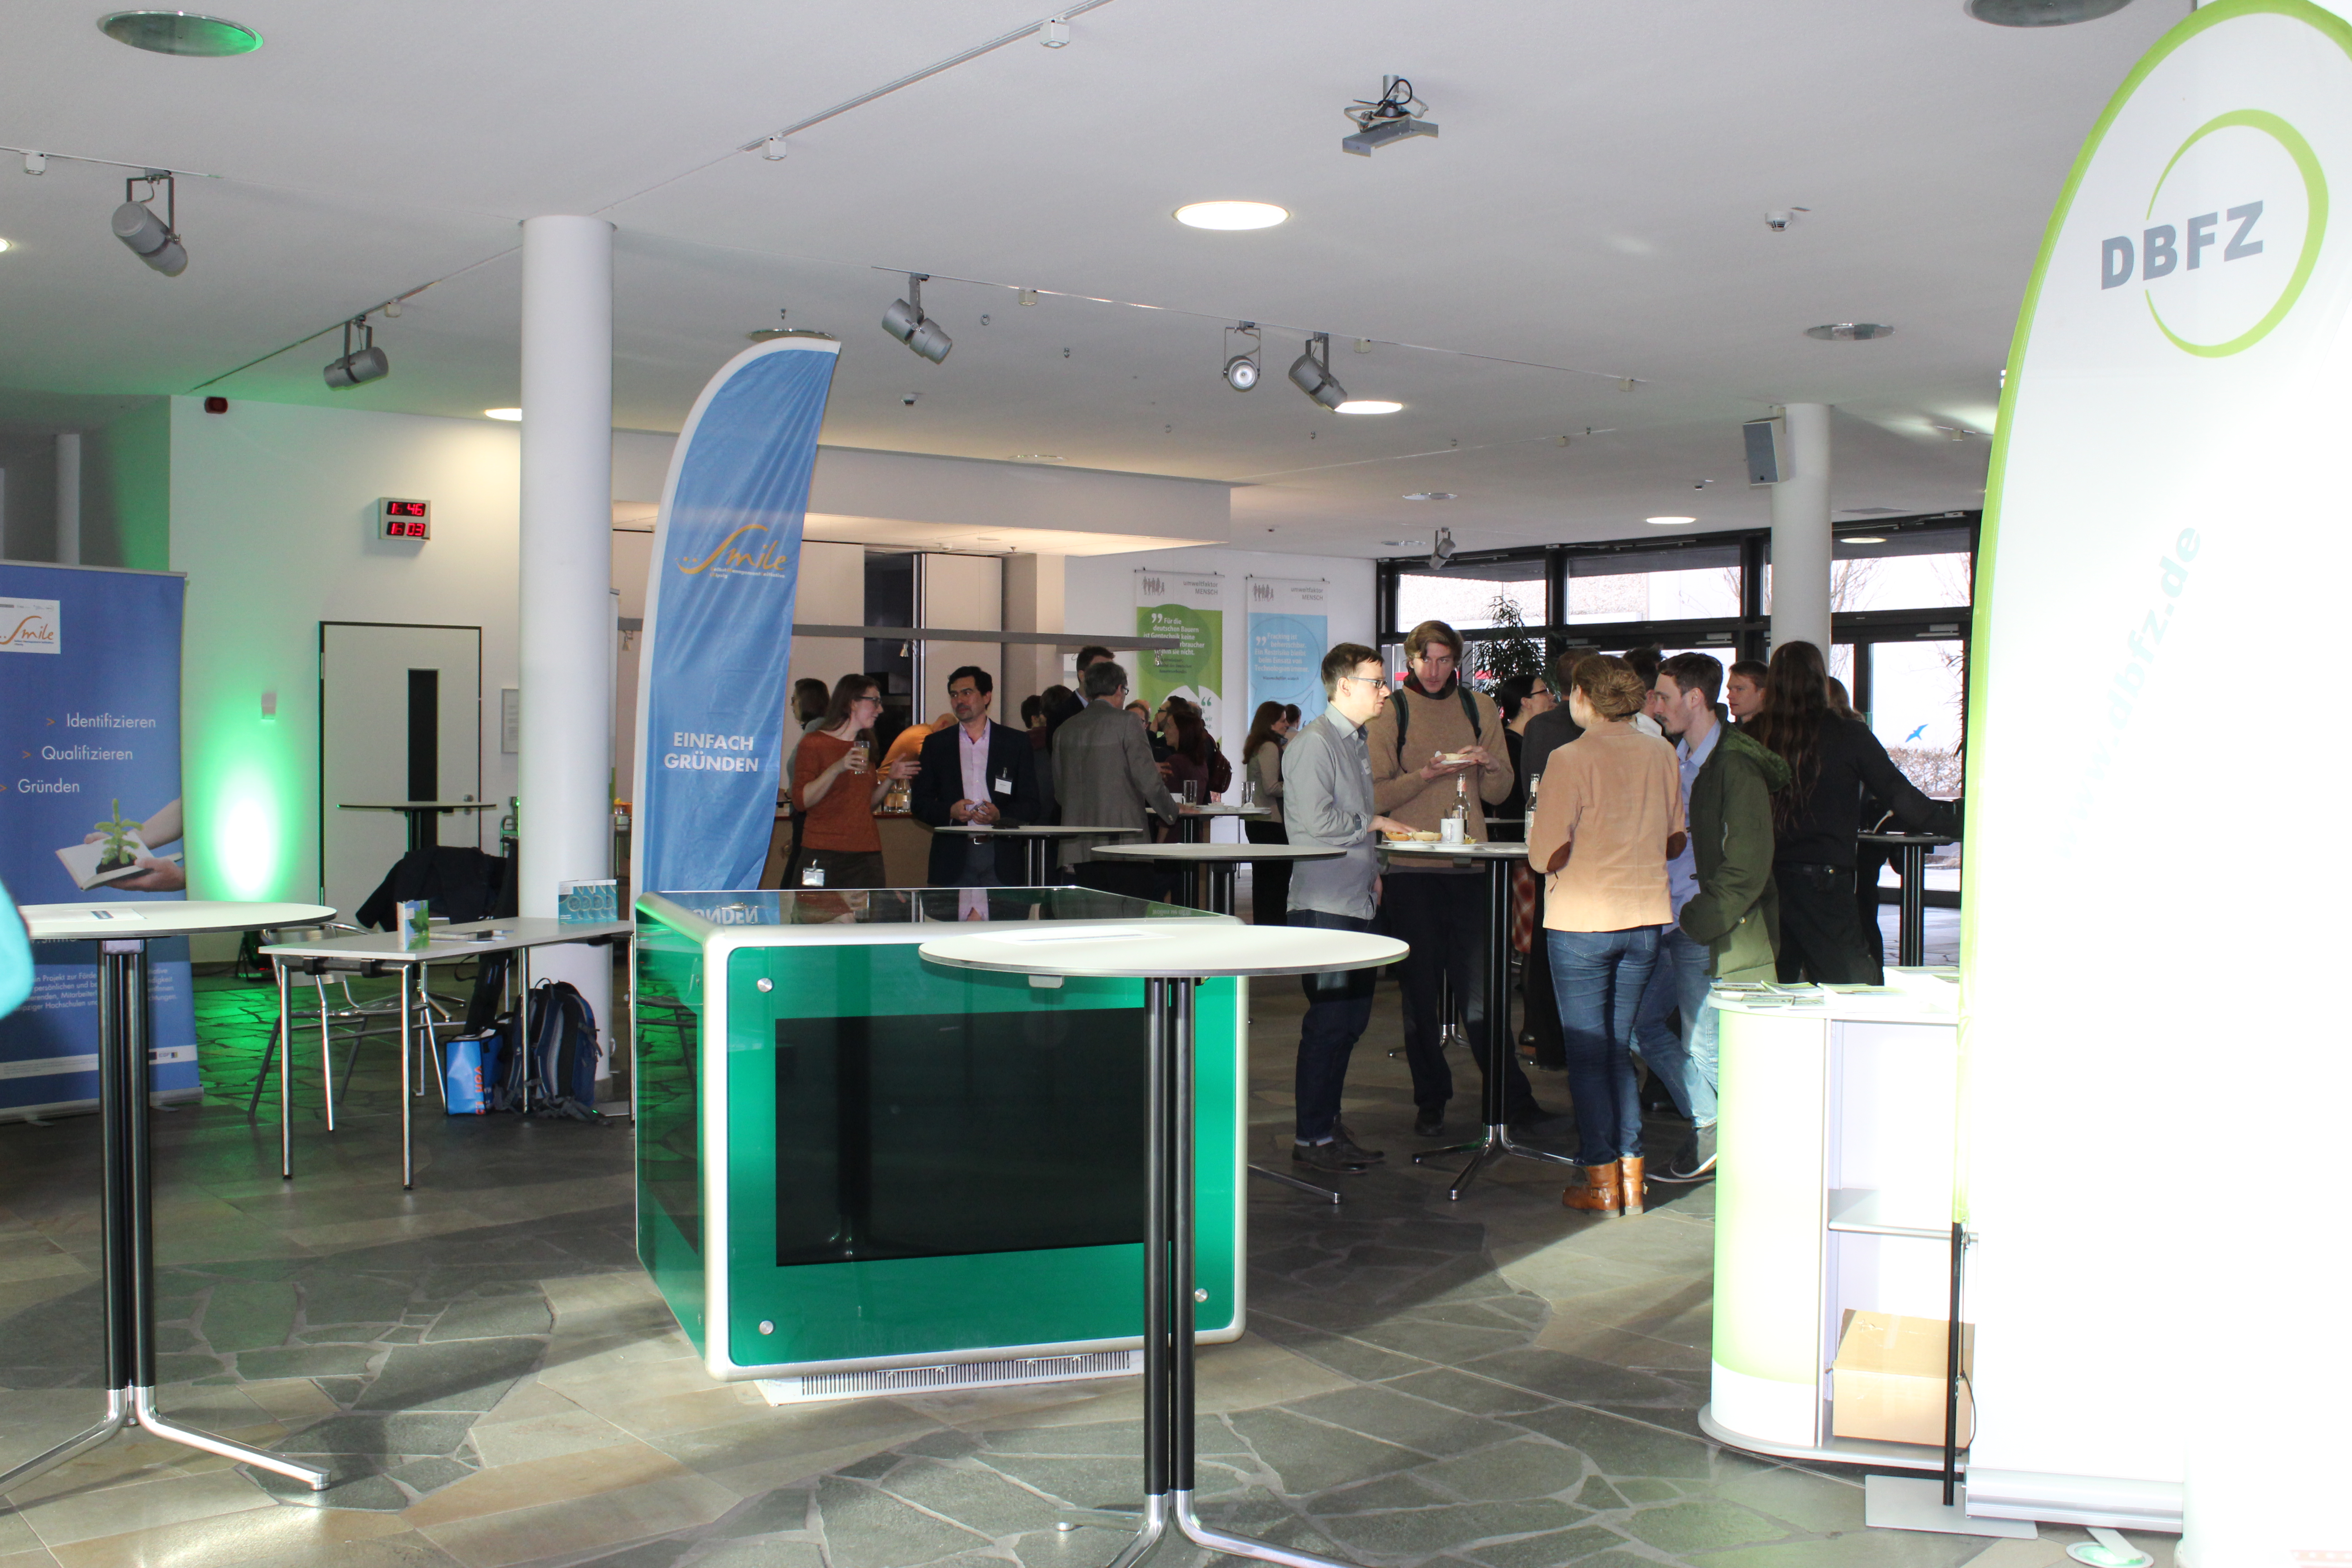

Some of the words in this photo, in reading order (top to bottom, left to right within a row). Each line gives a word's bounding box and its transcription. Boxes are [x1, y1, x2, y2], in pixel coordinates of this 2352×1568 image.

[2100, 199, 2264, 291] DBFZ
[407, 503, 424, 516] 46
[407, 523, 424, 536] 03
[1267, 632, 1290, 641] Fracking
[1254, 664, 1290, 673] Technologien
[2053, 527, 2201, 858] www.dbfz.de
[66, 713, 156, 729] Identifizieren
[673, 731, 754, 751] EINFACH
[41, 745, 133, 761] Qualifizieren
[664, 750, 759, 773] GRÜNDEN
[18, 778, 80, 794] Gründen
[43, 974, 65, 983] Projekt
[34, 983, 75, 993] persönlichen
[16, 1004, 44, 1013] eipziger
[45, 1000, 85, 1009] Hochschulen
